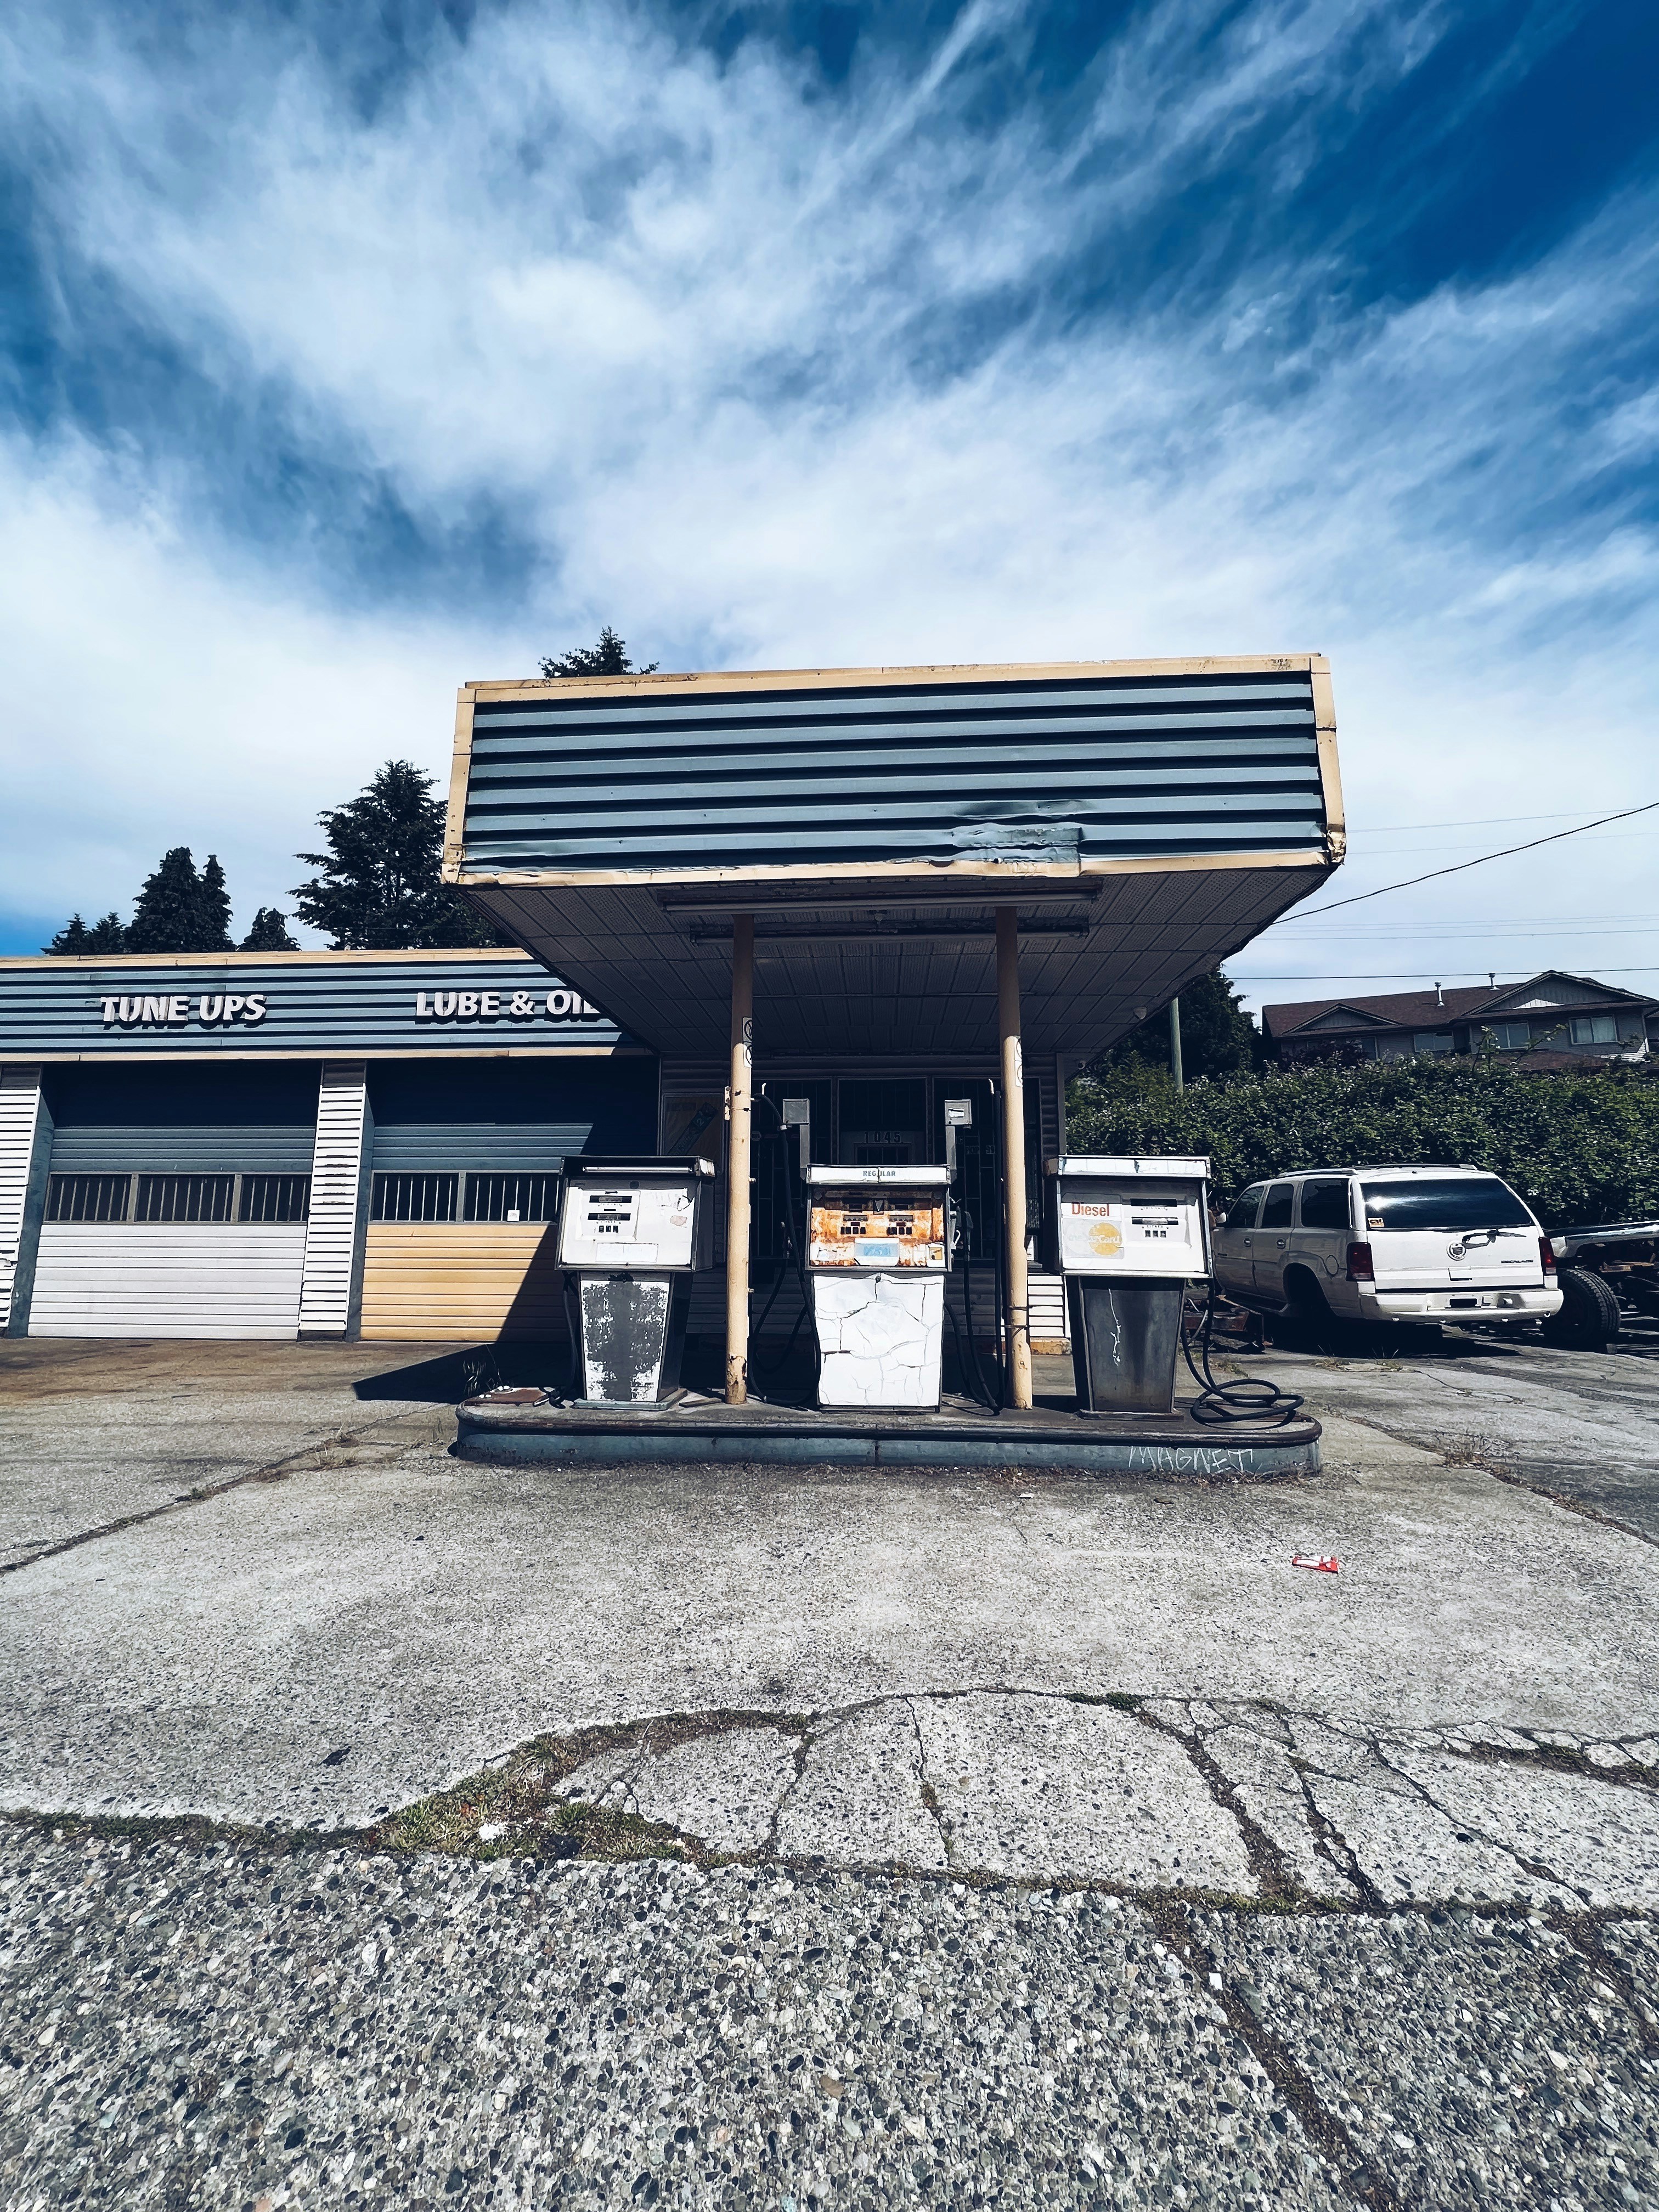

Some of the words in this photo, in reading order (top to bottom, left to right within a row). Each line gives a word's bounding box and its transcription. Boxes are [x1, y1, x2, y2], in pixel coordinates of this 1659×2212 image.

[100, 996, 190, 1022] TUNE
[199, 994, 266, 1021] UPS
[416, 991, 500, 1016] LUBE
[510, 991, 535, 1015] &
[865, 1131, 901, 1143] 1045
[1071, 1201, 1110, 1217] Diesel
[1128, 1446, 1253, 1474] MAGNET
